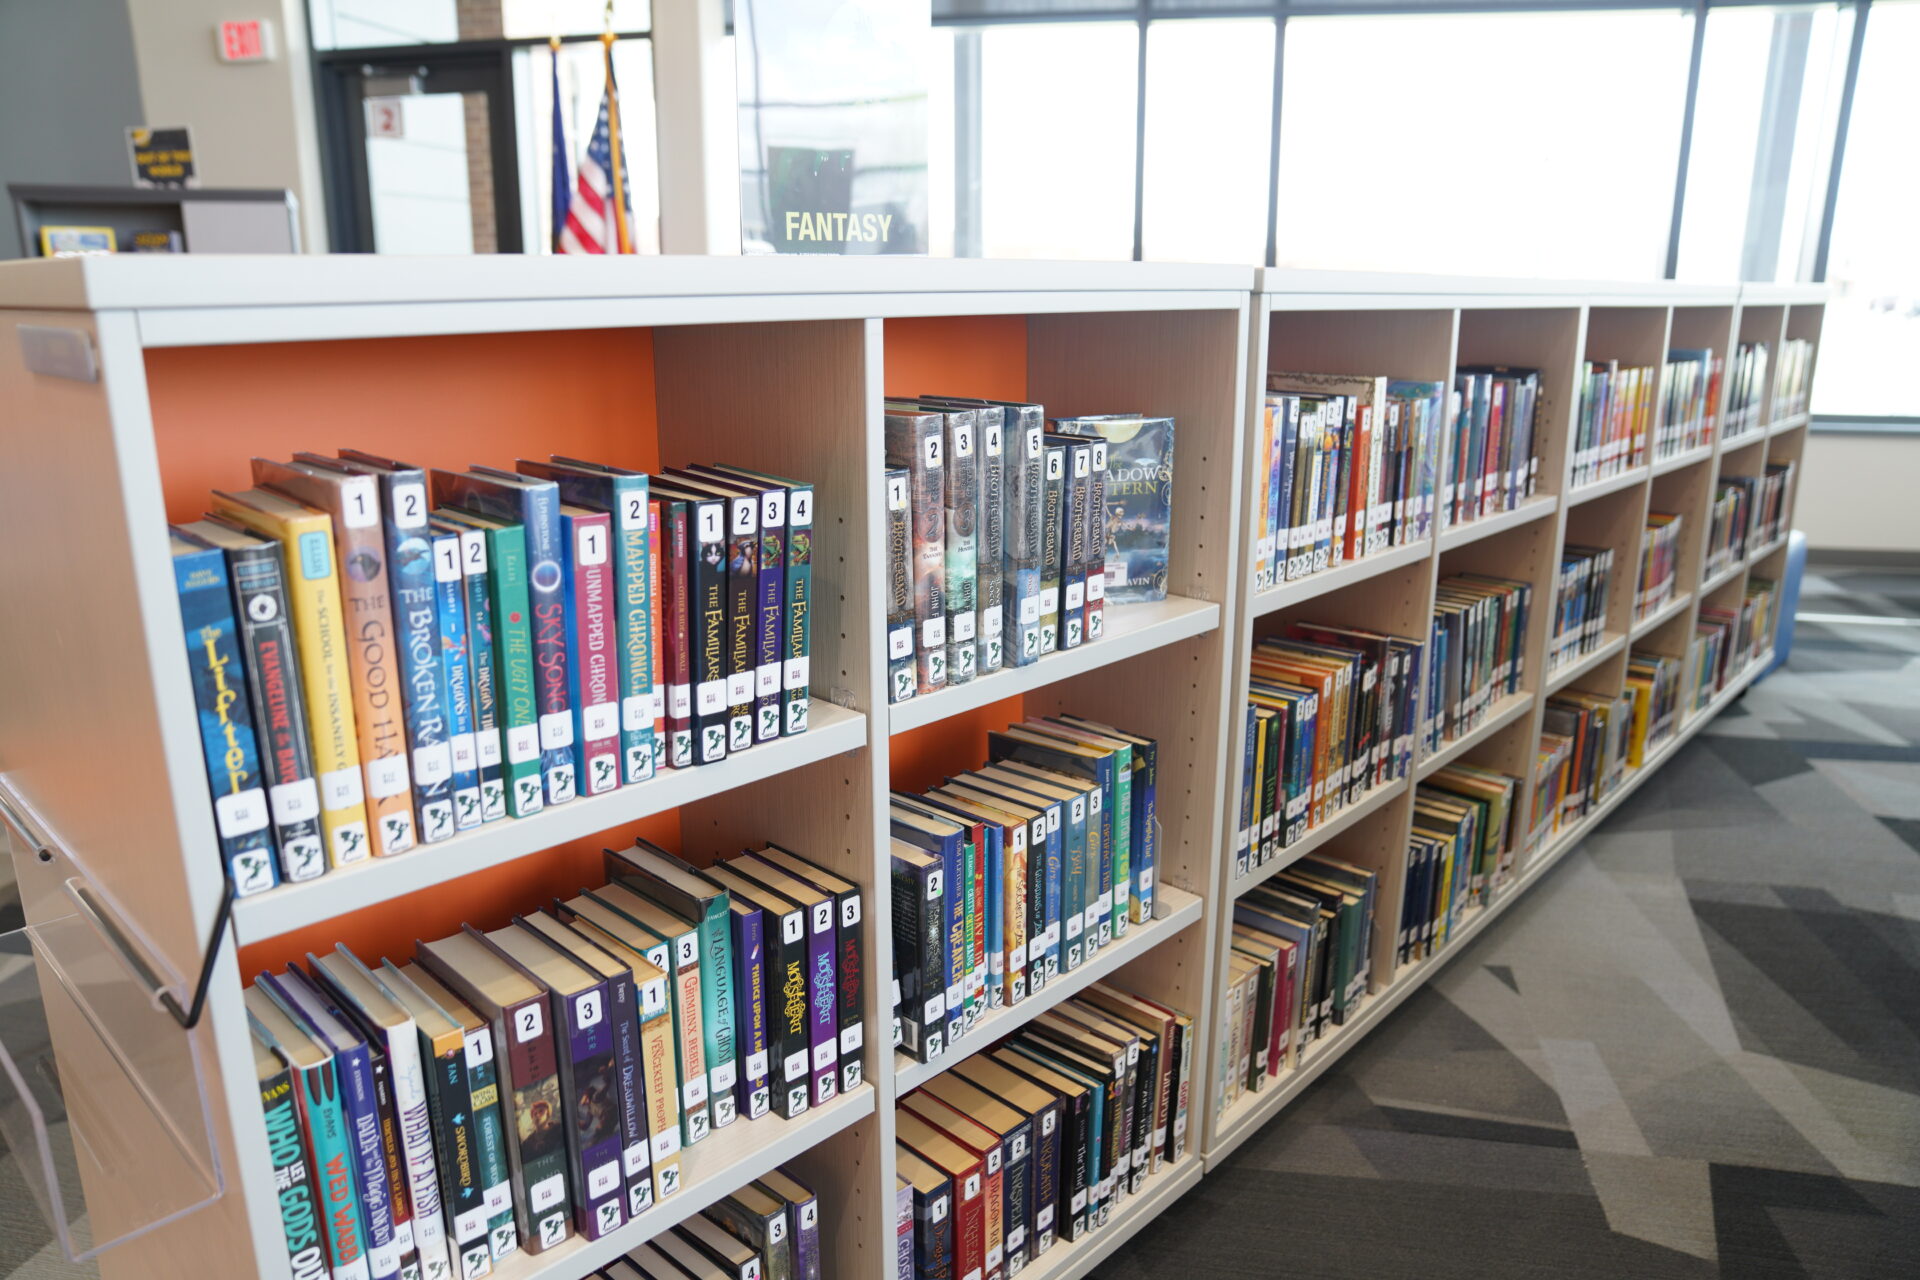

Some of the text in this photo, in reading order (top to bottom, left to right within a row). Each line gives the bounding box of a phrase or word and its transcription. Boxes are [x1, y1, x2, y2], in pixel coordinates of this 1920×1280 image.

[222, 21, 263, 60] EXIT
[380, 106, 395, 131] 2
[785, 211, 893, 242] FANTASY
[1329, 408, 1334, 419] 2
[960, 434, 968, 450] 3
[990, 432, 997, 448] 4
[1032, 435, 1039, 451] 5
[930, 441, 938, 459] 2
[1096, 450, 1102, 465] 8
[1051, 458, 1057, 474] 6
[1079, 455, 1085, 470] 7
[1105, 465, 1161, 482] ADOW
[893, 484, 900, 501] 1
[353, 493, 365, 515] 1
[405, 494, 417, 516] 2
[630, 500, 640, 519] 2
[768, 501, 777, 519] 3
[796, 499, 805, 517] 4
[706, 513, 713, 532] 1
[740, 507, 749, 525] 2
[1073, 486, 1085, 560] BROTHERBAND
[1046, 490, 1058, 566] BROTHERBAND
[470, 542, 481, 563] 2
[588, 534, 595, 555] 1
[443, 549, 453, 570] 1
[625, 530, 645, 605] MAPPED
[649, 553, 657, 597] CINDERELLA
[398, 586, 433, 604] THE
[708, 584, 718, 608] THE
[768, 581, 776, 603] THE
[796, 578, 804, 600] THE
[931, 586, 939, 609] JOHN
[350, 595, 385, 612] THE
[586, 568, 605, 651] UNMAPPED
[738, 589, 747, 613] THE
[508, 629, 527, 655] THE
[357, 620, 389, 709] GOOD
[409, 608, 440, 714] BROKEN
[535, 603, 568, 714] SKY SONG
[511, 659, 529, 693] UGLY
[1076, 803, 1081, 817] 2
[1093, 796, 1098, 809] 3
[1050, 813, 1055, 826] 1
[1016, 832, 1021, 845] 1
[1036, 824, 1042, 837] 2
[930, 877, 937, 892] 2
[819, 910, 827, 925] 2
[847, 905, 854, 920] 3
[953, 899, 963, 921] THE
[789, 920, 796, 935] 1
[683, 943, 691, 958] 3
[654, 953, 663, 968] 2
[710, 938, 728, 1017] LANGUAGE
[649, 987, 656, 1003] 1
[752, 963, 762, 1039] THRICE UPON A
[583, 1002, 593, 1020] 3
[524, 1014, 534, 1031] 2
[473, 1039, 482, 1056] 1
[1131, 1048, 1137, 1059] 2
[448, 1063, 458, 1085] FAN
[1118, 1060, 1123, 1071] 1
[623, 1065, 638, 1138] DREADWILLOW
[323, 1107, 337, 1139] EVANS
[404, 1100, 431, 1150] WHAT
[1045, 1117, 1051, 1129] 3
[265, 1100, 301, 1167] WHO
[483, 1116, 494, 1152] FOREST
[1016, 1141, 1022, 1154] 2
[411, 1149, 433, 1167] IF
[454, 1126, 472, 1188] SWORDBIRD
[992, 1155, 998, 1167] 2
[289, 1160, 306, 1183] LET
[413, 1168, 435, 1183] A
[1040, 1134, 1054, 1202] NKDEATH
[274, 1166, 292, 1191] THE
[325, 1152, 349, 1203] WED
[969, 1180, 975, 1192] 1
[415, 1181, 441, 1220] FISH
[937, 1203, 942, 1214] 1
[280, 1184, 318, 1253] GODS
[807, 1208, 814, 1222] 4
[774, 1223, 781, 1237] 3
[748, 1266, 754, 1279] 4
